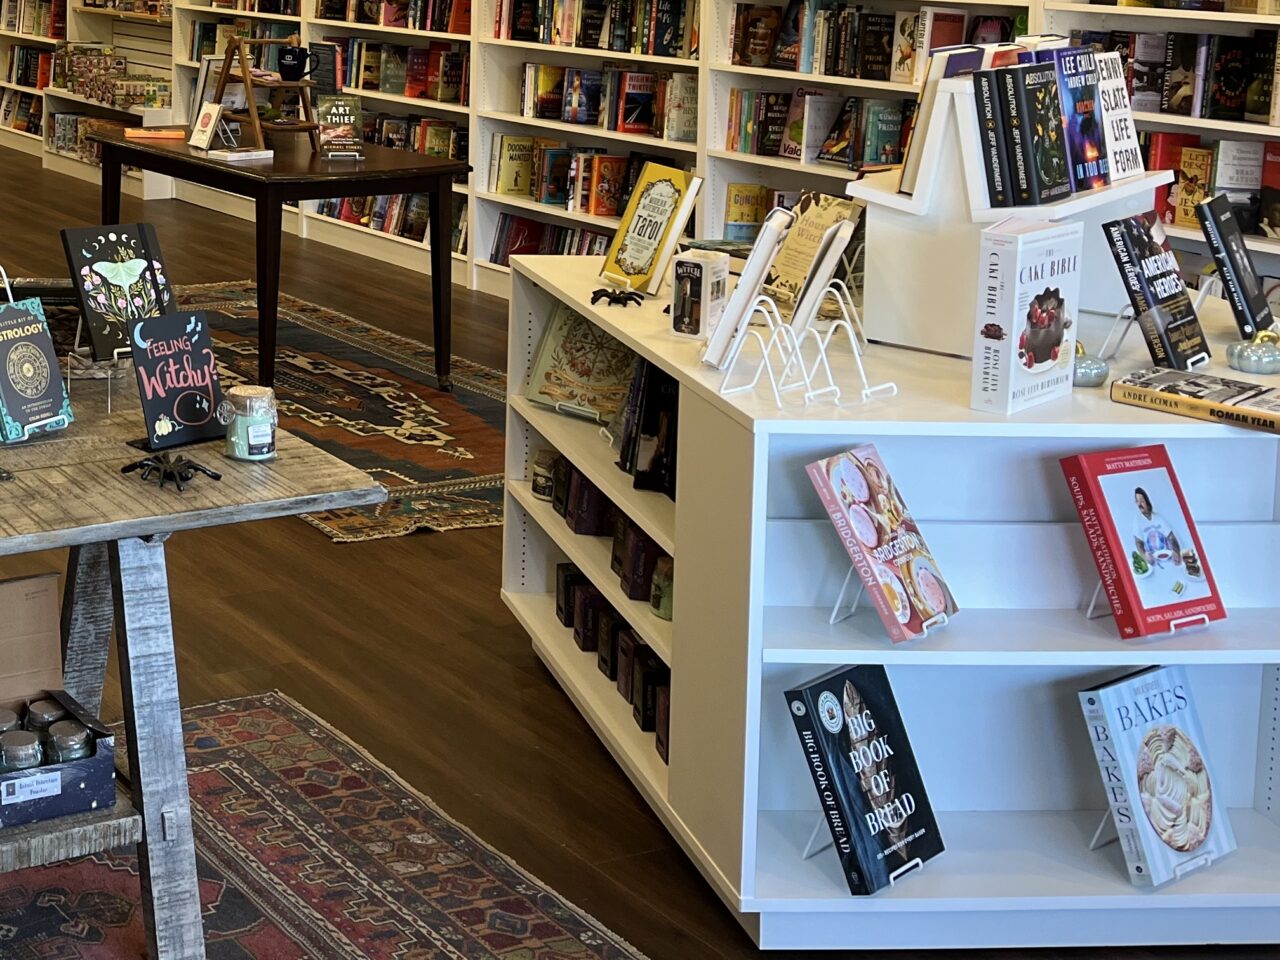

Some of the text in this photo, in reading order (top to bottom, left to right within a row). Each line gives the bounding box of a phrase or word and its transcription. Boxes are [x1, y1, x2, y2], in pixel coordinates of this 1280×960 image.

[659, 0, 671, 11] Life
[1025, 70, 1056, 85] ABSOLUTION
[1061, 53, 1095, 75] LEE CHILD
[1161, 34, 1175, 110] MYSTERY LIGHTS
[1067, 76, 1086, 89] ANDREW
[330, 106, 351, 115] ART
[1101, 87, 1128, 112] SLATE
[326, 115, 356, 124] THIEF
[980, 77, 1003, 191] ABSOLUTION JEFF VANDERMEER
[1005, 73, 1028, 190] ABSOLUTION JEFF VANDERMEER
[1111, 118, 1132, 141] LIFE
[508, 152, 531, 162] WANTED
[1076, 161, 1099, 179] IN TOO
[1114, 147, 1141, 173] FORM
[1019, 255, 1078, 285] CAKE BIBLE
[1109, 226, 1130, 263] AMERICAN
[1123, 262, 1141, 291] HEROES
[1141, 250, 1180, 278] AMERICAN
[1205, 221, 1243, 310] BROTHERS ALEX VAN HALEN
[986, 253, 1000, 316] CAKE BIBLE
[1153, 274, 1182, 299] HEROES
[0, 319, 17, 328] LITTLE
[145, 336, 192, 359] FEELING
[138, 348, 218, 425] Witchy?
[1150, 397, 1179, 409] ACIMAN
[1209, 408, 1249, 424] ROMAN
[1251, 416, 1276, 429] YEAR
[1106, 458, 1153, 471] MATTY MATHESON
[832, 512, 876, 586] BRIDGERTON
[874, 532, 922, 564] BRIDGERTON
[1070, 476, 1124, 616] SOUPS, SALADS, SANDWICHES
[1088, 508, 1118, 580] MATTY MATHESON
[1116, 685, 1189, 732] BAKES
[847, 709, 876, 739] BIG
[848, 734, 894, 774] BOOK
[802, 730, 851, 854] BIG BOOK OF BREAD
[870, 769, 891, 797] OF
[865, 792, 916, 837] BREAD
